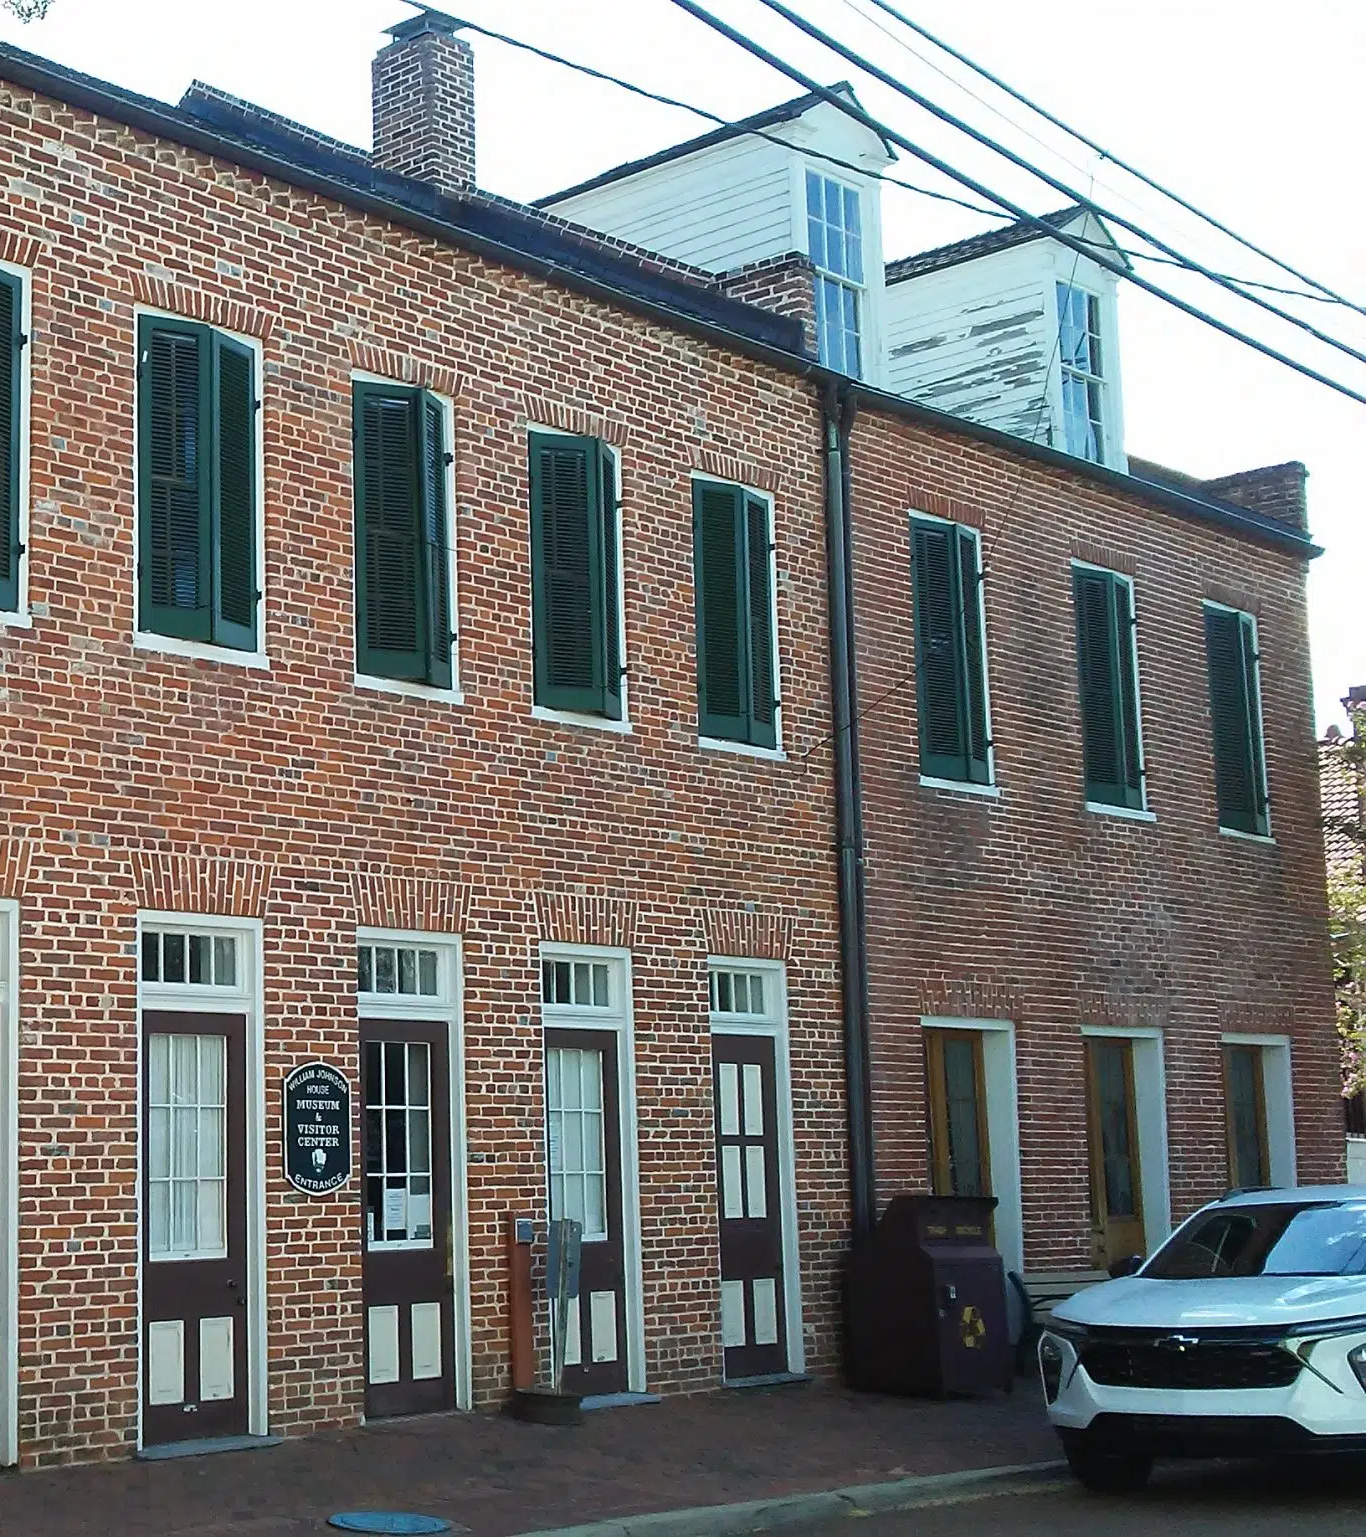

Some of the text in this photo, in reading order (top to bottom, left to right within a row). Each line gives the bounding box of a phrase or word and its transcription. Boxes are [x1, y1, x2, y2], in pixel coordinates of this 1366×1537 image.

[289, 1070, 347, 1093] WILLIAM JOHNSON
[306, 1085, 330, 1095] HOUSE
[296, 1100, 340, 1110] MUSEUM
[315, 1112, 322, 1122] &
[297, 1124, 340, 1135] VISITOR
[297, 1136, 340, 1147] CENTER
[294, 1172, 343, 1190] ENTRANCE
